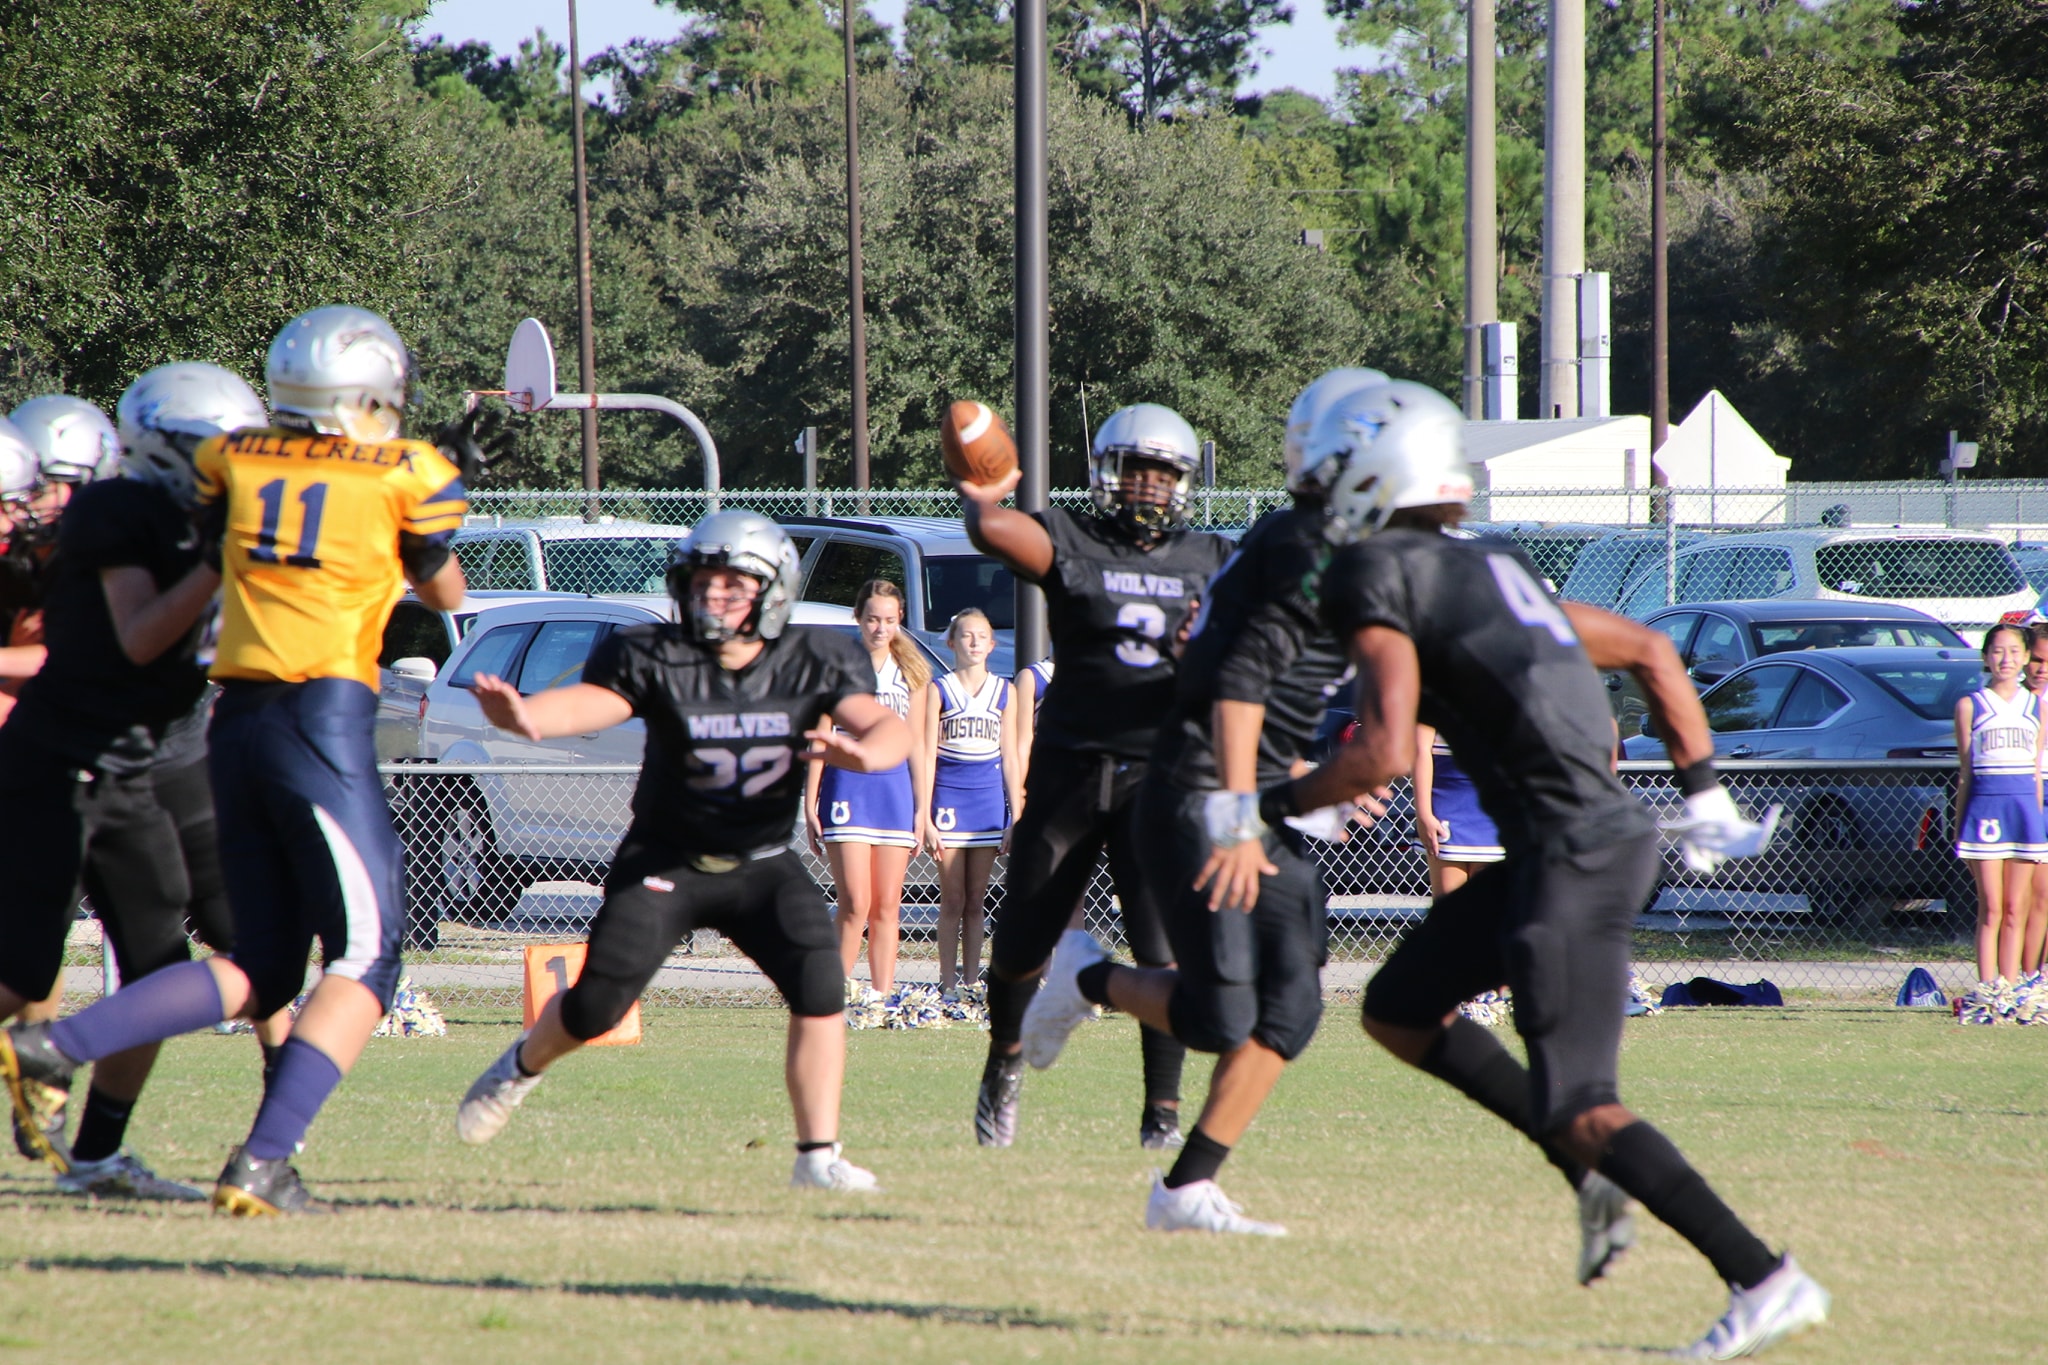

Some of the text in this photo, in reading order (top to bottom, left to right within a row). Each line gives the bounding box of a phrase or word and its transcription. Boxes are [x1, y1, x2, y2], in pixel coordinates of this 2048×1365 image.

[219, 432, 418, 473] MILL CREEK
[247, 478, 328, 568] 11
[1102, 570, 1184, 598] WOLVES
[1486, 553, 1578, 646] 4
[1115, 602, 1166, 668] 3
[688, 712, 791, 739] WOLVES
[684, 745, 793, 798] 32
